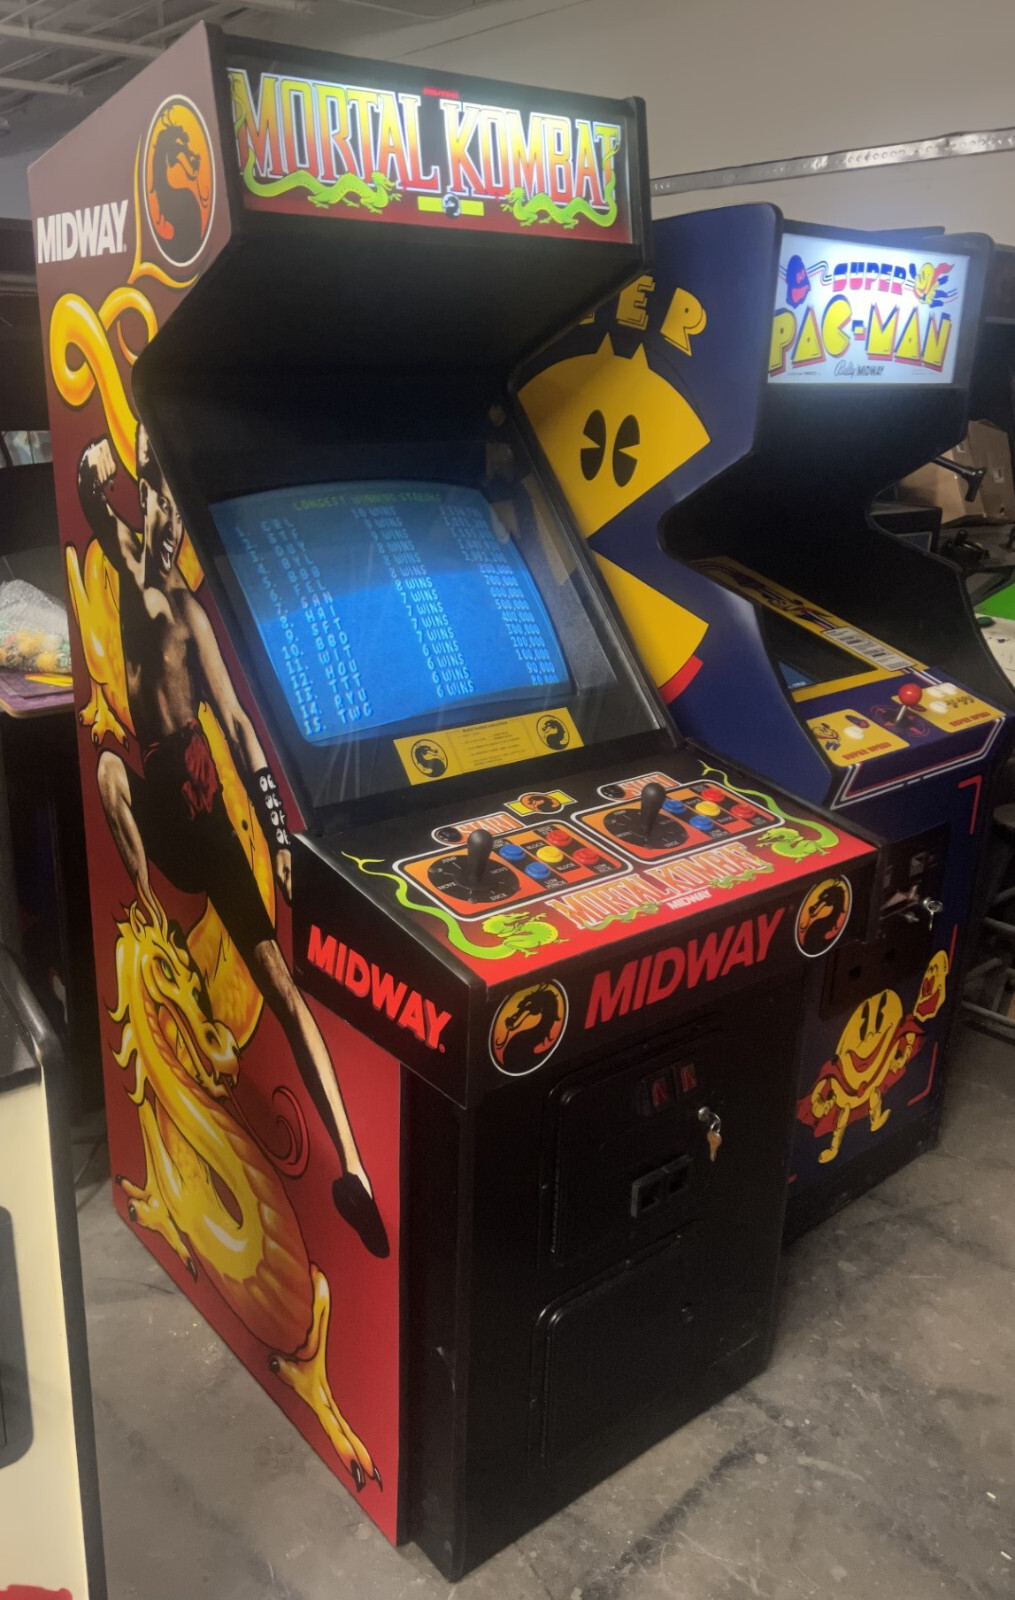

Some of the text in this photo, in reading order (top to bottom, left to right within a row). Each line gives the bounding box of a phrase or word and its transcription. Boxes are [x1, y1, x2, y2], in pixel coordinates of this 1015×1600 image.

[227, 68, 621, 209] MORTAL KOMBAT
[37, 199, 129, 264] MIDWAY
[833, 261, 907, 295] SUPER
[768, 294, 953, 378] PAC-MAN
[856, 365, 885, 376] MIDWAY
[294, 495, 346, 511] LONGEST
[400, 564, 427, 577] WINS
[405, 576, 433, 590] WINS
[401, 592, 407, 604] 7
[410, 588, 438, 602] WINS
[405, 605, 412, 617] 7
[416, 601, 443, 615] WINS
[282, 643, 304, 660] 10.
[410, 617, 418, 630] 7
[421, 614, 449, 628] WINS
[286, 659, 308, 675] 11.
[416, 630, 422, 642] 7
[426, 627, 454, 641] WINS
[291, 672, 313, 690] 12.
[422, 643, 429, 657] 6
[431, 640, 459, 655] WINS
[510, 635, 545, 648] 200,000
[427, 657, 434, 670] 6
[436, 653, 464, 668] WINS
[432, 670, 439, 684] 6
[441, 666, 470, 682] WINS
[304, 717, 326, 735] 15.
[436, 684, 444, 698] 6
[446, 680, 474, 696] WINS
[454, 814, 518, 837] START
[526, 842, 545, 850] BLOCK
[556, 863, 575, 871] BLOCK
[545, 841, 767, 929] MORTAL KOMBAT
[667, 890, 712, 910] MIDWAY
[584, 908, 786, 1030] MIDWAY
[307, 924, 452, 1050] MIDWAY
